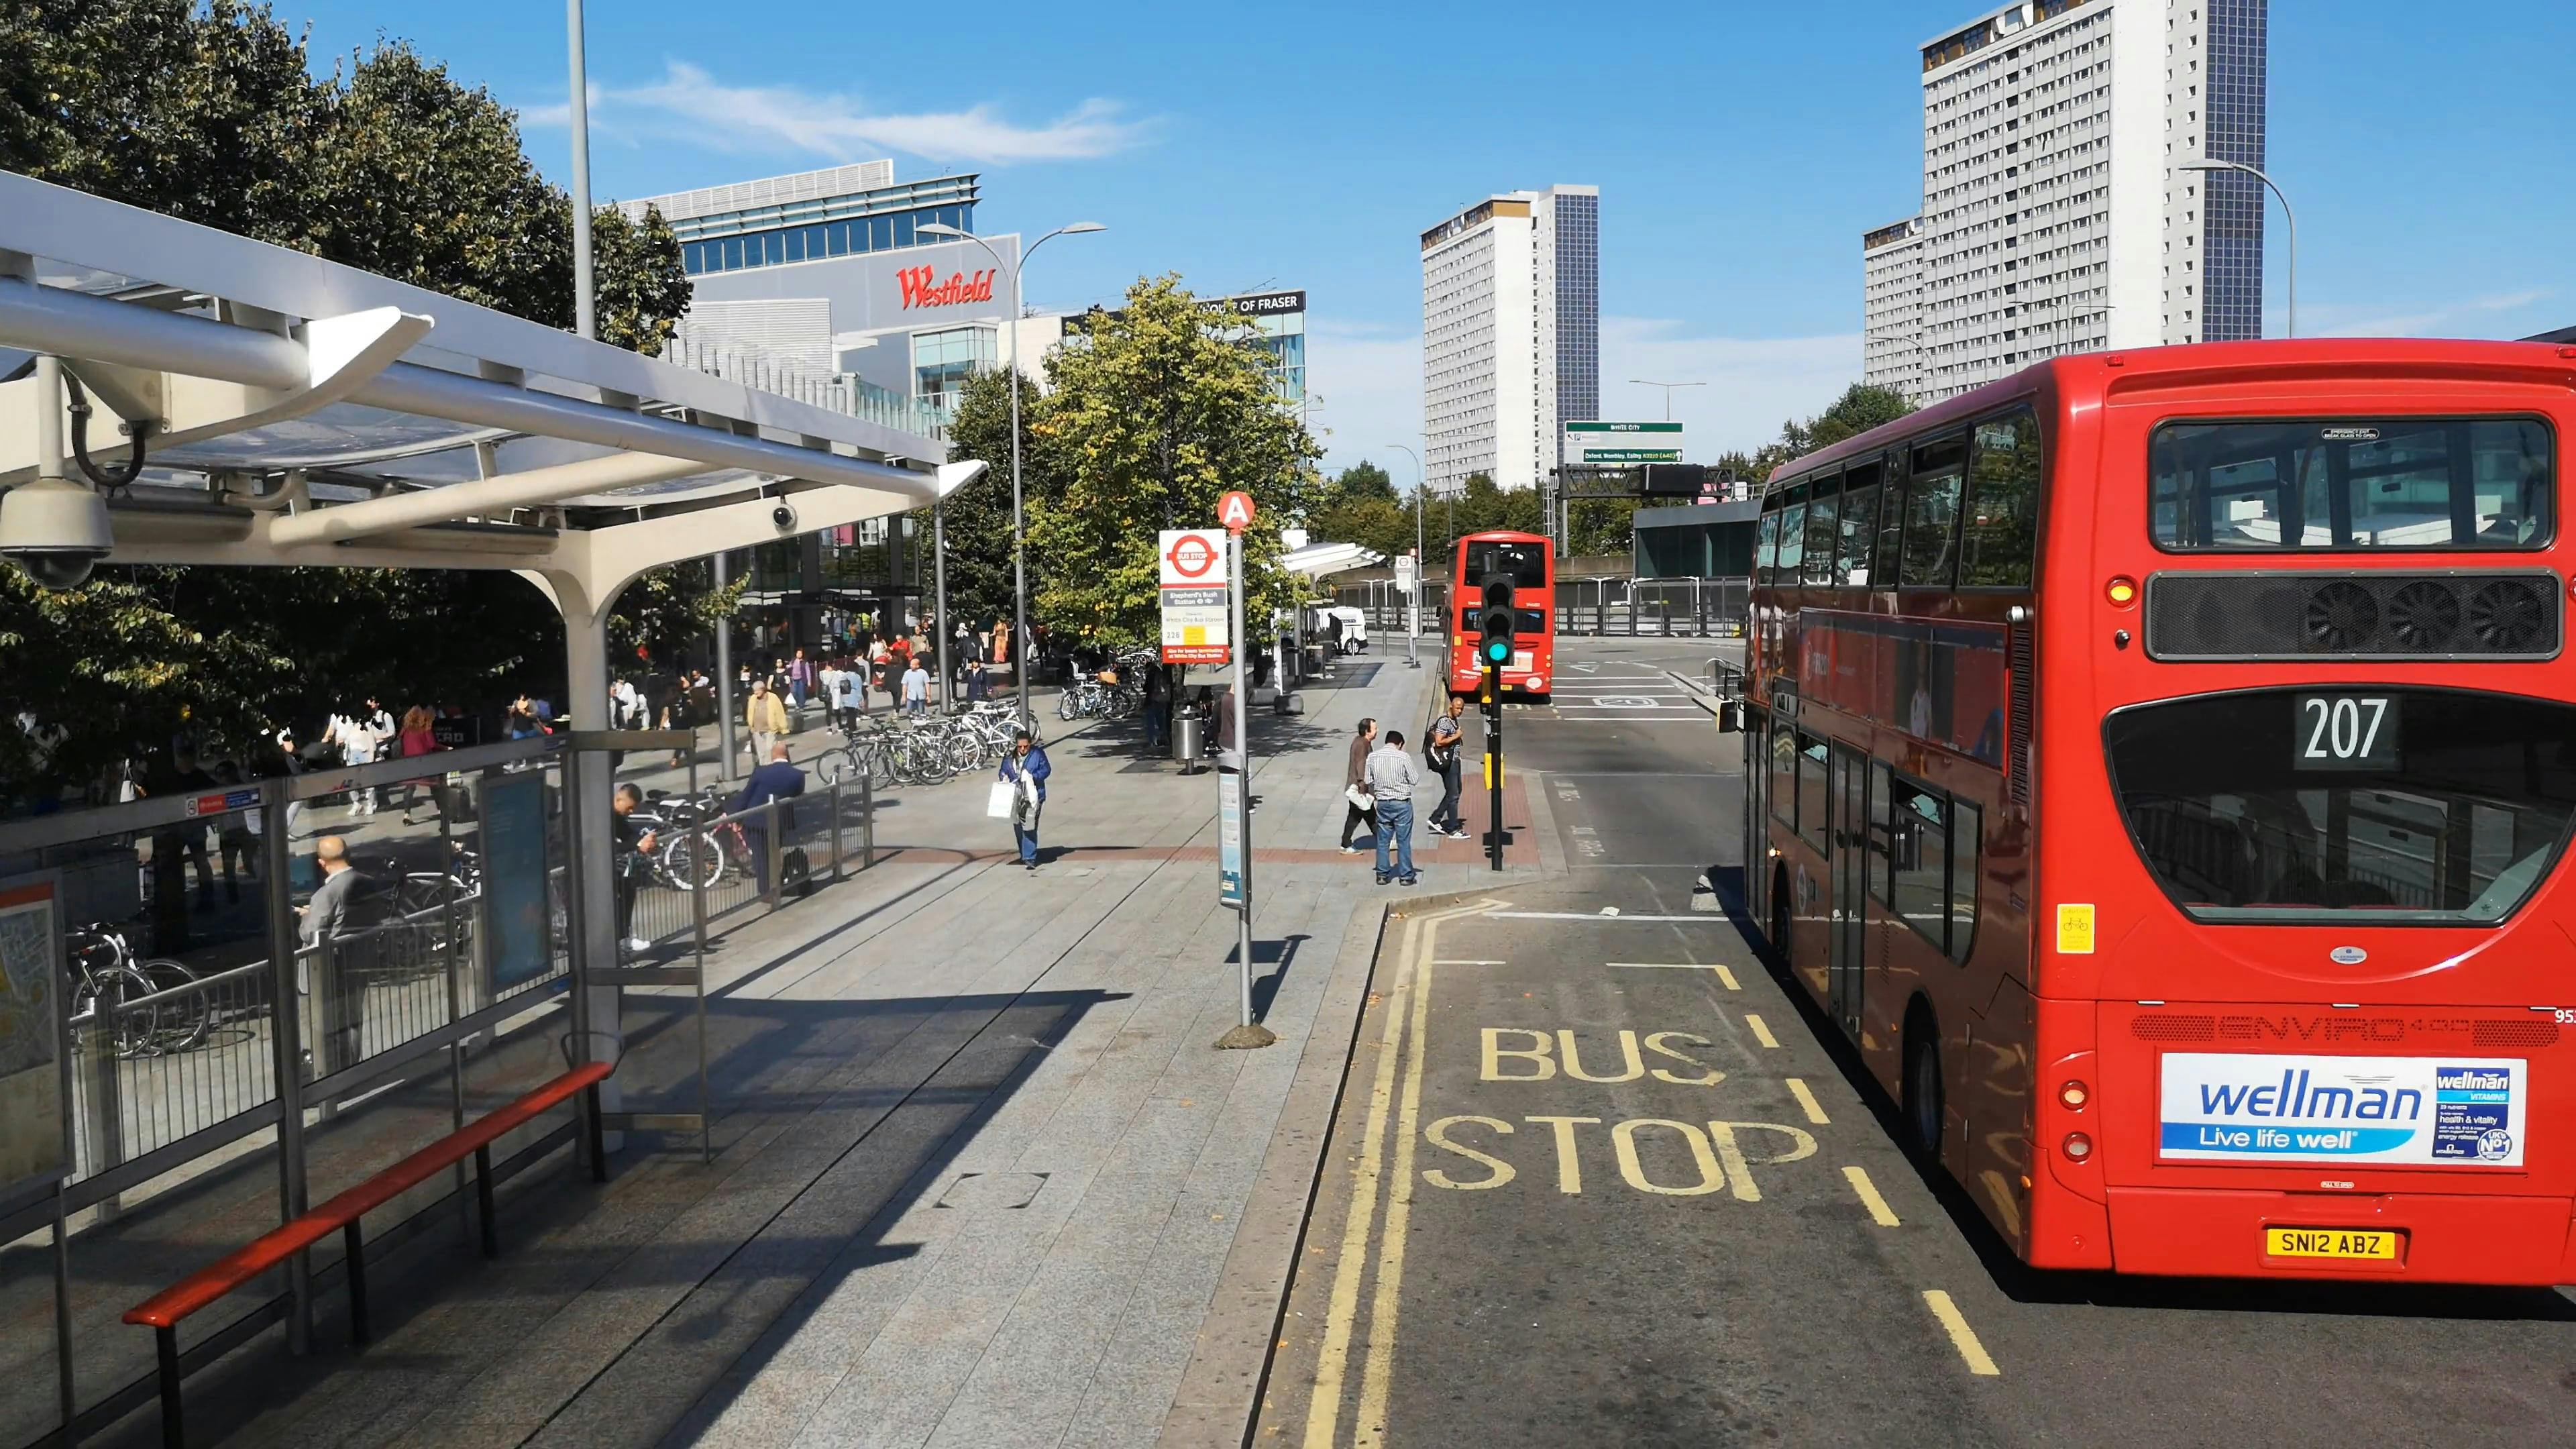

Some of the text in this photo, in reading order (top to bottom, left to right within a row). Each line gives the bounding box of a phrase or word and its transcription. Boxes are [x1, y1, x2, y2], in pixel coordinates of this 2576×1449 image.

[896, 265, 996, 310] Westfield
[1240, 300, 1256, 312] OF
[1258, 296, 1297, 311] FRASER
[1224, 496, 1249, 524] A
[2304, 698, 2388, 758] 207
[2555, 1010, 2576, 1023] 95
[2219, 1016, 2405, 1041] ENVIRO
[1480, 1028, 1727, 1086] BUS
[2437, 1071, 2508, 1089] wellman
[2200, 1069, 2422, 1120] wellman
[2470, 1093, 2507, 1101] VITAMINS
[2439, 1116, 2498, 1125] health & vitality
[2200, 1128, 2353, 1149] Live life well
[1421, 1116, 1819, 1202] STOP
[2282, 1233, 2380, 1254] SN12 ABZ
